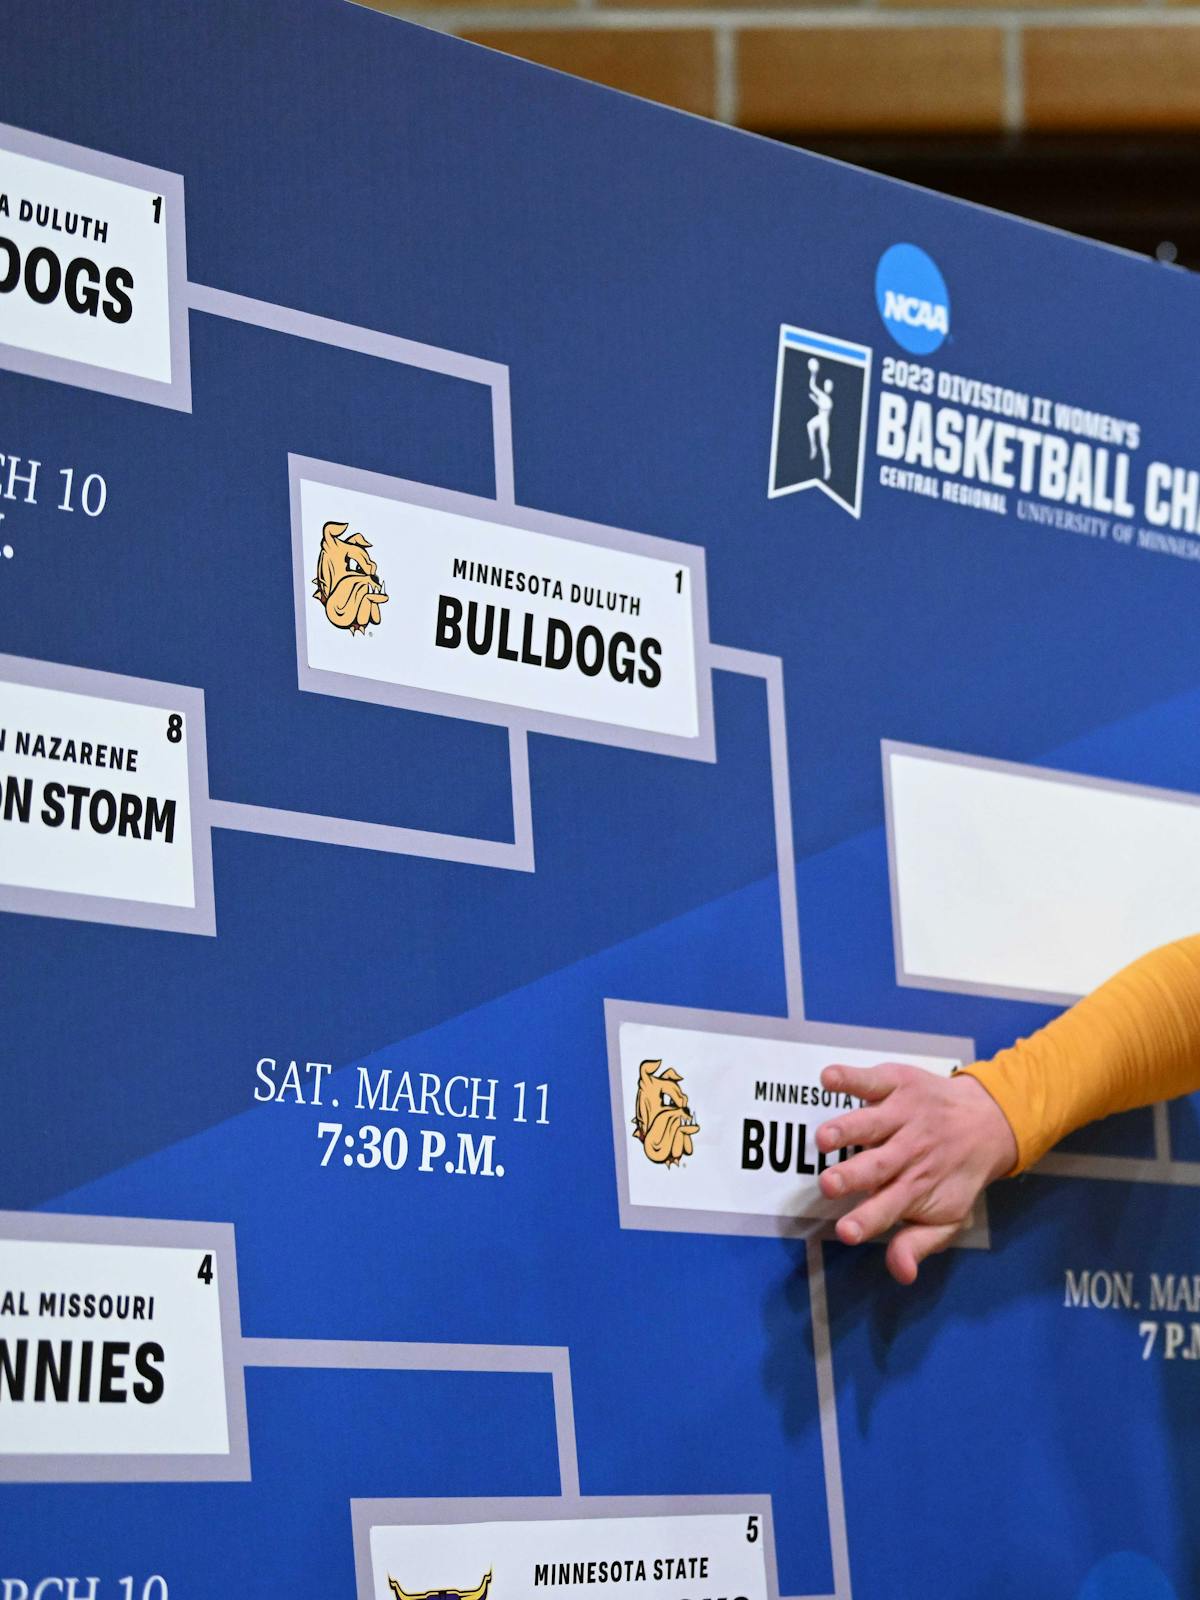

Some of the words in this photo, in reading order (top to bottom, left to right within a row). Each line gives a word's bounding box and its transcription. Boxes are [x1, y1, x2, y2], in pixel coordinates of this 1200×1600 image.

[19, 199, 109, 243] DULUTH
[152, 196, 162, 224] 1
[884, 290, 948, 335] NCAA
[881, 356, 935, 395] 2023
[937, 371, 1029, 421] DIVISION
[1031, 396, 1052, 427] II
[1054, 402, 1141, 450] WOMEN'S
[876, 391, 1135, 518] BASKETBALL
[58, 468, 107, 517] 10
[879, 465, 939, 499] CENTRAL
[942, 480, 1007, 515] REGIONAL
[1017, 500, 1111, 539] UNIVERSITY
[1111, 522, 1135, 545] OF
[453, 558, 563, 600] MINNESOTA
[570, 583, 641, 617] DULUTH
[674, 569, 683, 594] 1
[435, 594, 662, 689] BULLDOGS
[166, 713, 183, 743] 8
[15, 731, 138, 772] NAZARENE
[41, 782, 177, 843] STORM
[253, 1057, 339, 1108] SAT.
[355, 1066, 499, 1120] MARCH
[513, 1081, 549, 1125] 11
[317, 1121, 408, 1170] 7:30
[418, 1129, 505, 1177] P.M.
[197, 1254, 213, 1285] 4
[1063, 1269, 1140, 1309] MON.
[39, 1292, 155, 1320] MISSOURI
[1138, 1321, 1158, 1360] 7
[746, 1516, 759, 1543] 5
[534, 1560, 647, 1586] MINNESOTA
[653, 1557, 709, 1581] STATE
